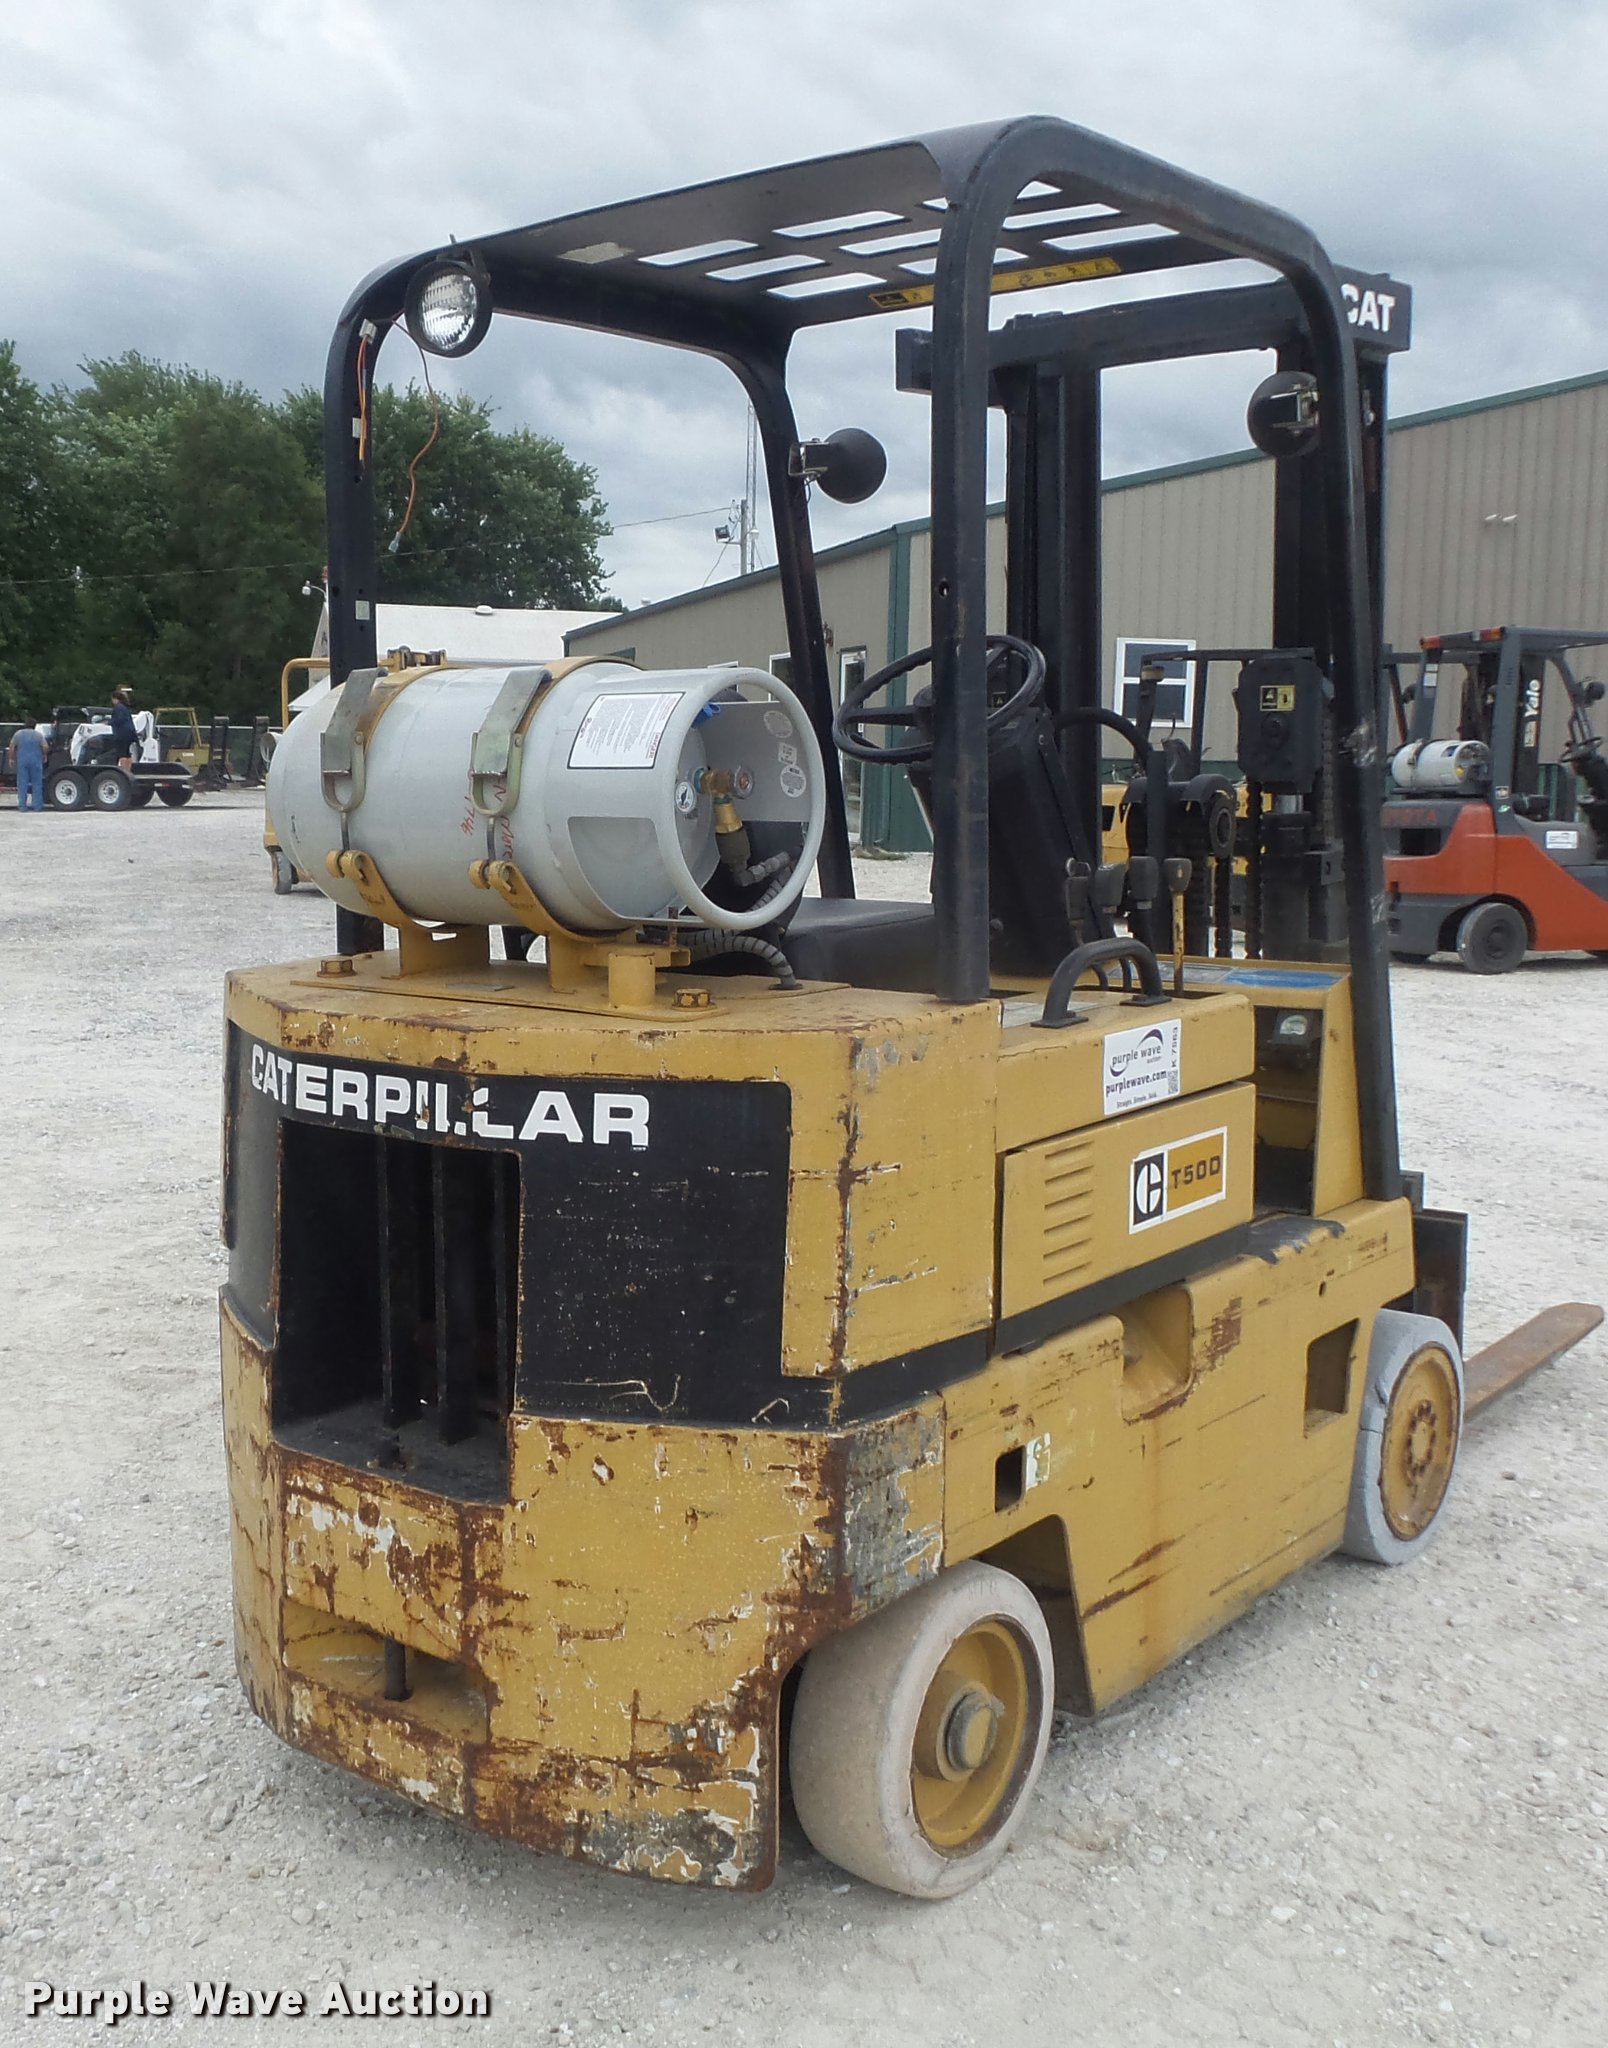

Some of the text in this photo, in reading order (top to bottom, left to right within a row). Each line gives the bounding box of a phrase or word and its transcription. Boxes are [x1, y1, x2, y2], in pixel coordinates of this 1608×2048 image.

[1341, 283, 1396, 333] CAT
[1112, 1045, 1162, 1067] purple wave
[251, 1043, 651, 1148] CATERPILLAR
[1106, 1070, 1167, 1097] purplewave.com
